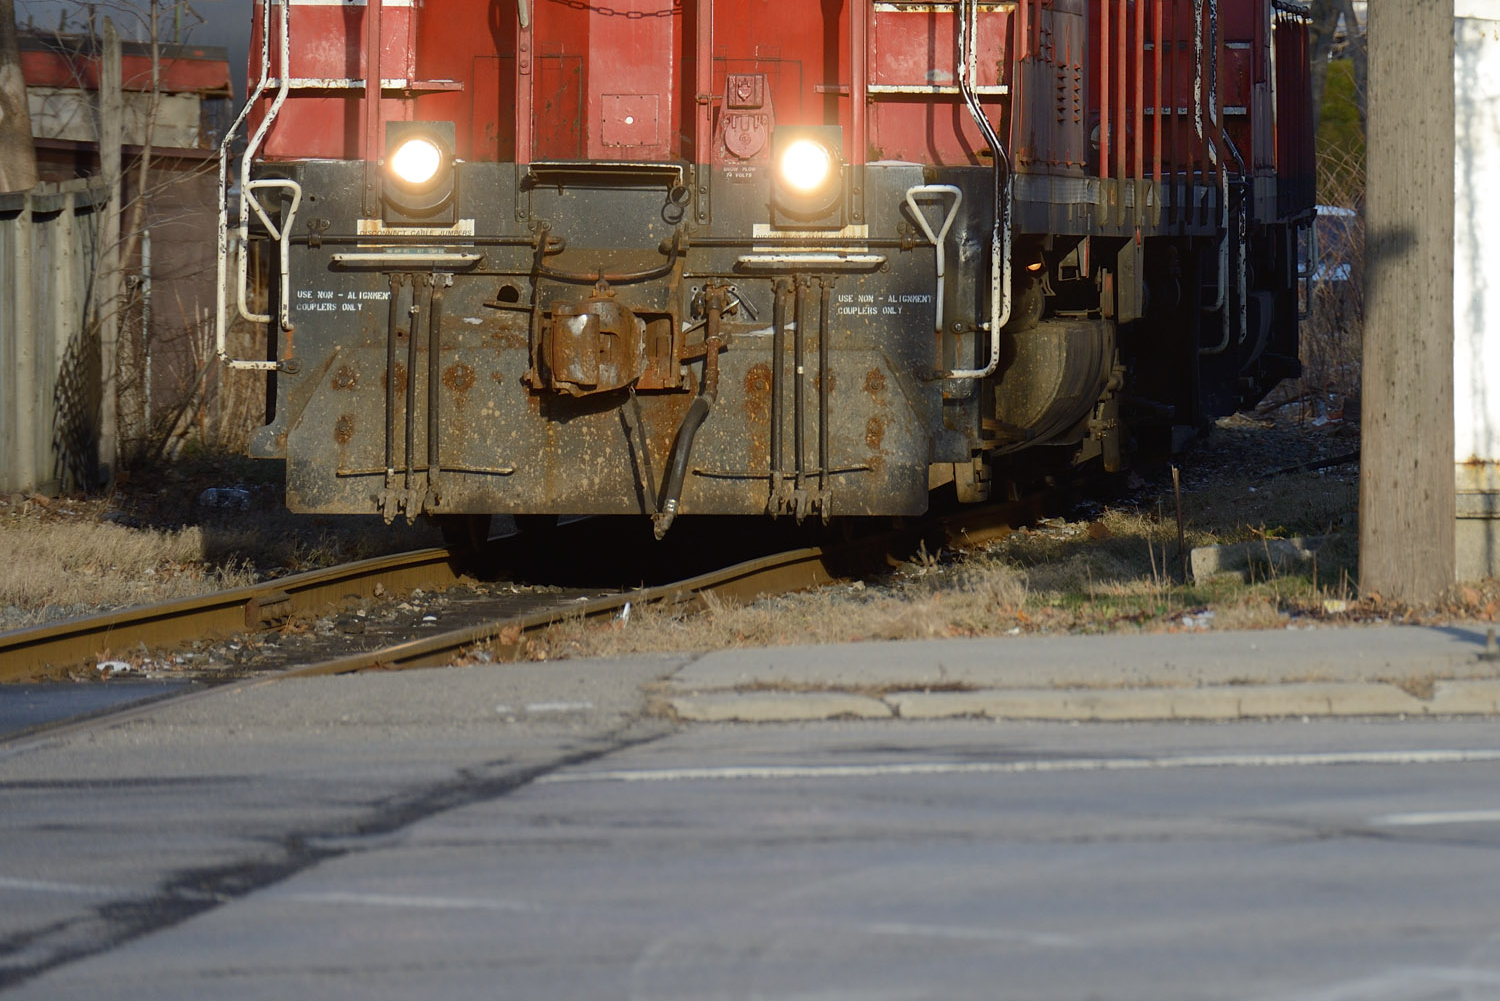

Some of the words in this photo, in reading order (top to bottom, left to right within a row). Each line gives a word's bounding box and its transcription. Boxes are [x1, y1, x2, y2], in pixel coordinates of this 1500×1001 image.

[297, 290, 313, 299] USE
[317, 290, 334, 299] NON
[838, 294, 854, 303] USE
[858, 294, 874, 303] NON
[888, 294, 932, 303] ALIGNMENT
[296, 303, 337, 311] COUPLERS
[342, 303, 363, 311] ONLY
[837, 306, 878, 315] COUPLERS
[882, 306, 903, 315] ONLY
